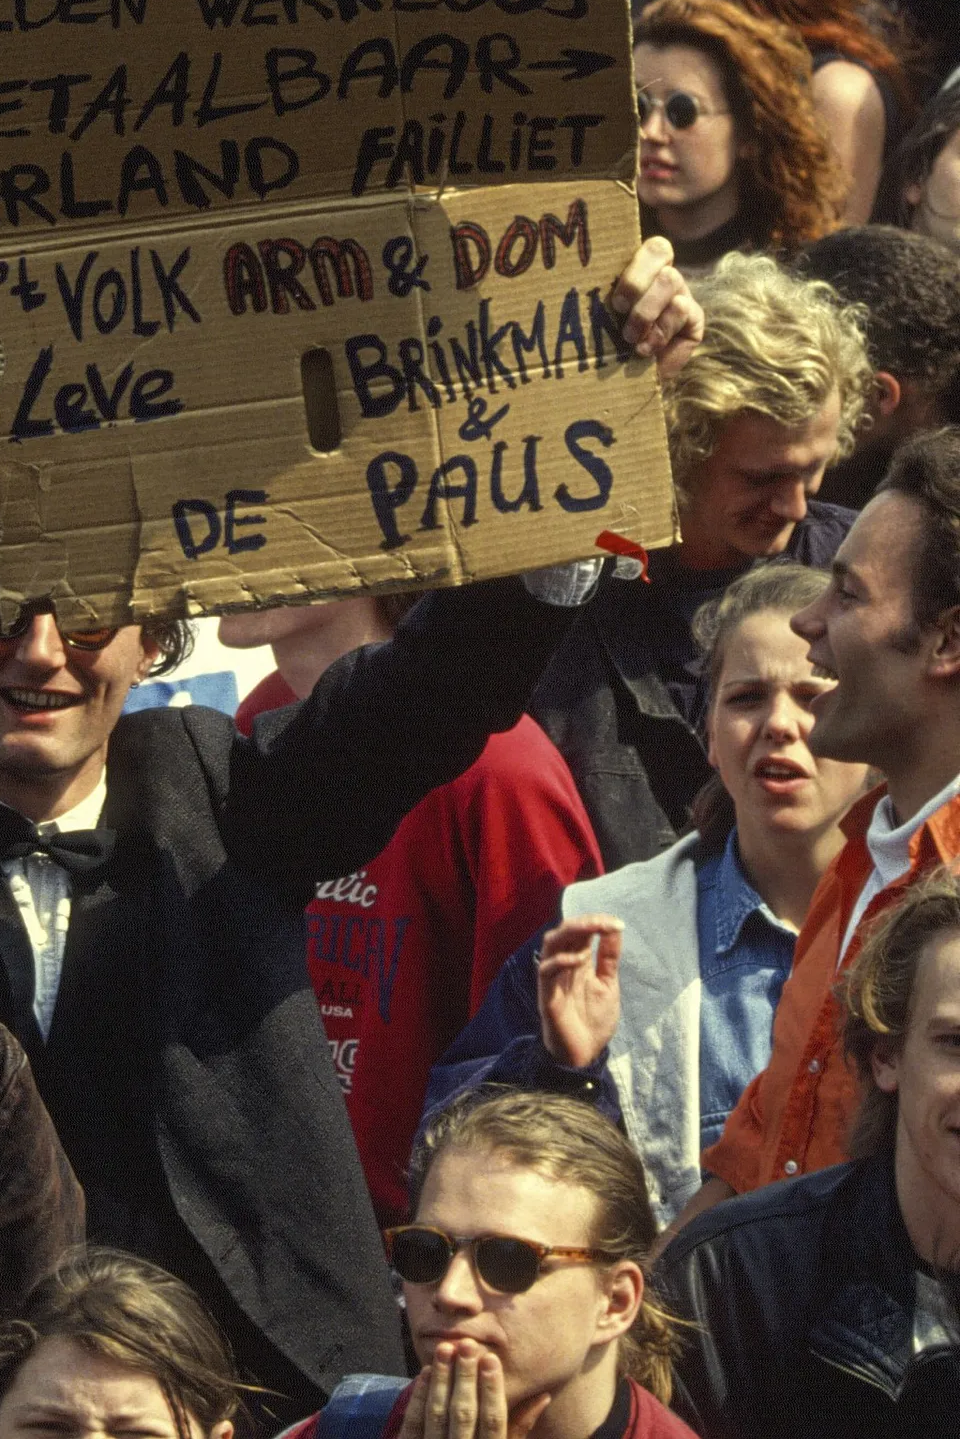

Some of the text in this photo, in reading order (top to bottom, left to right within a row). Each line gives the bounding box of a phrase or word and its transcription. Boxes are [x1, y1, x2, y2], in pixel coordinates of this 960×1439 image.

[55, 246, 202, 342] VOLK
[224, 236, 370, 315] ARM
[386, 235, 431, 298] &
[451, 198, 592, 290] DOM
[458, 397, 510, 442] &
[171, 419, 617, 559] DE PAUS
[321, 1005, 354, 1019] USA
